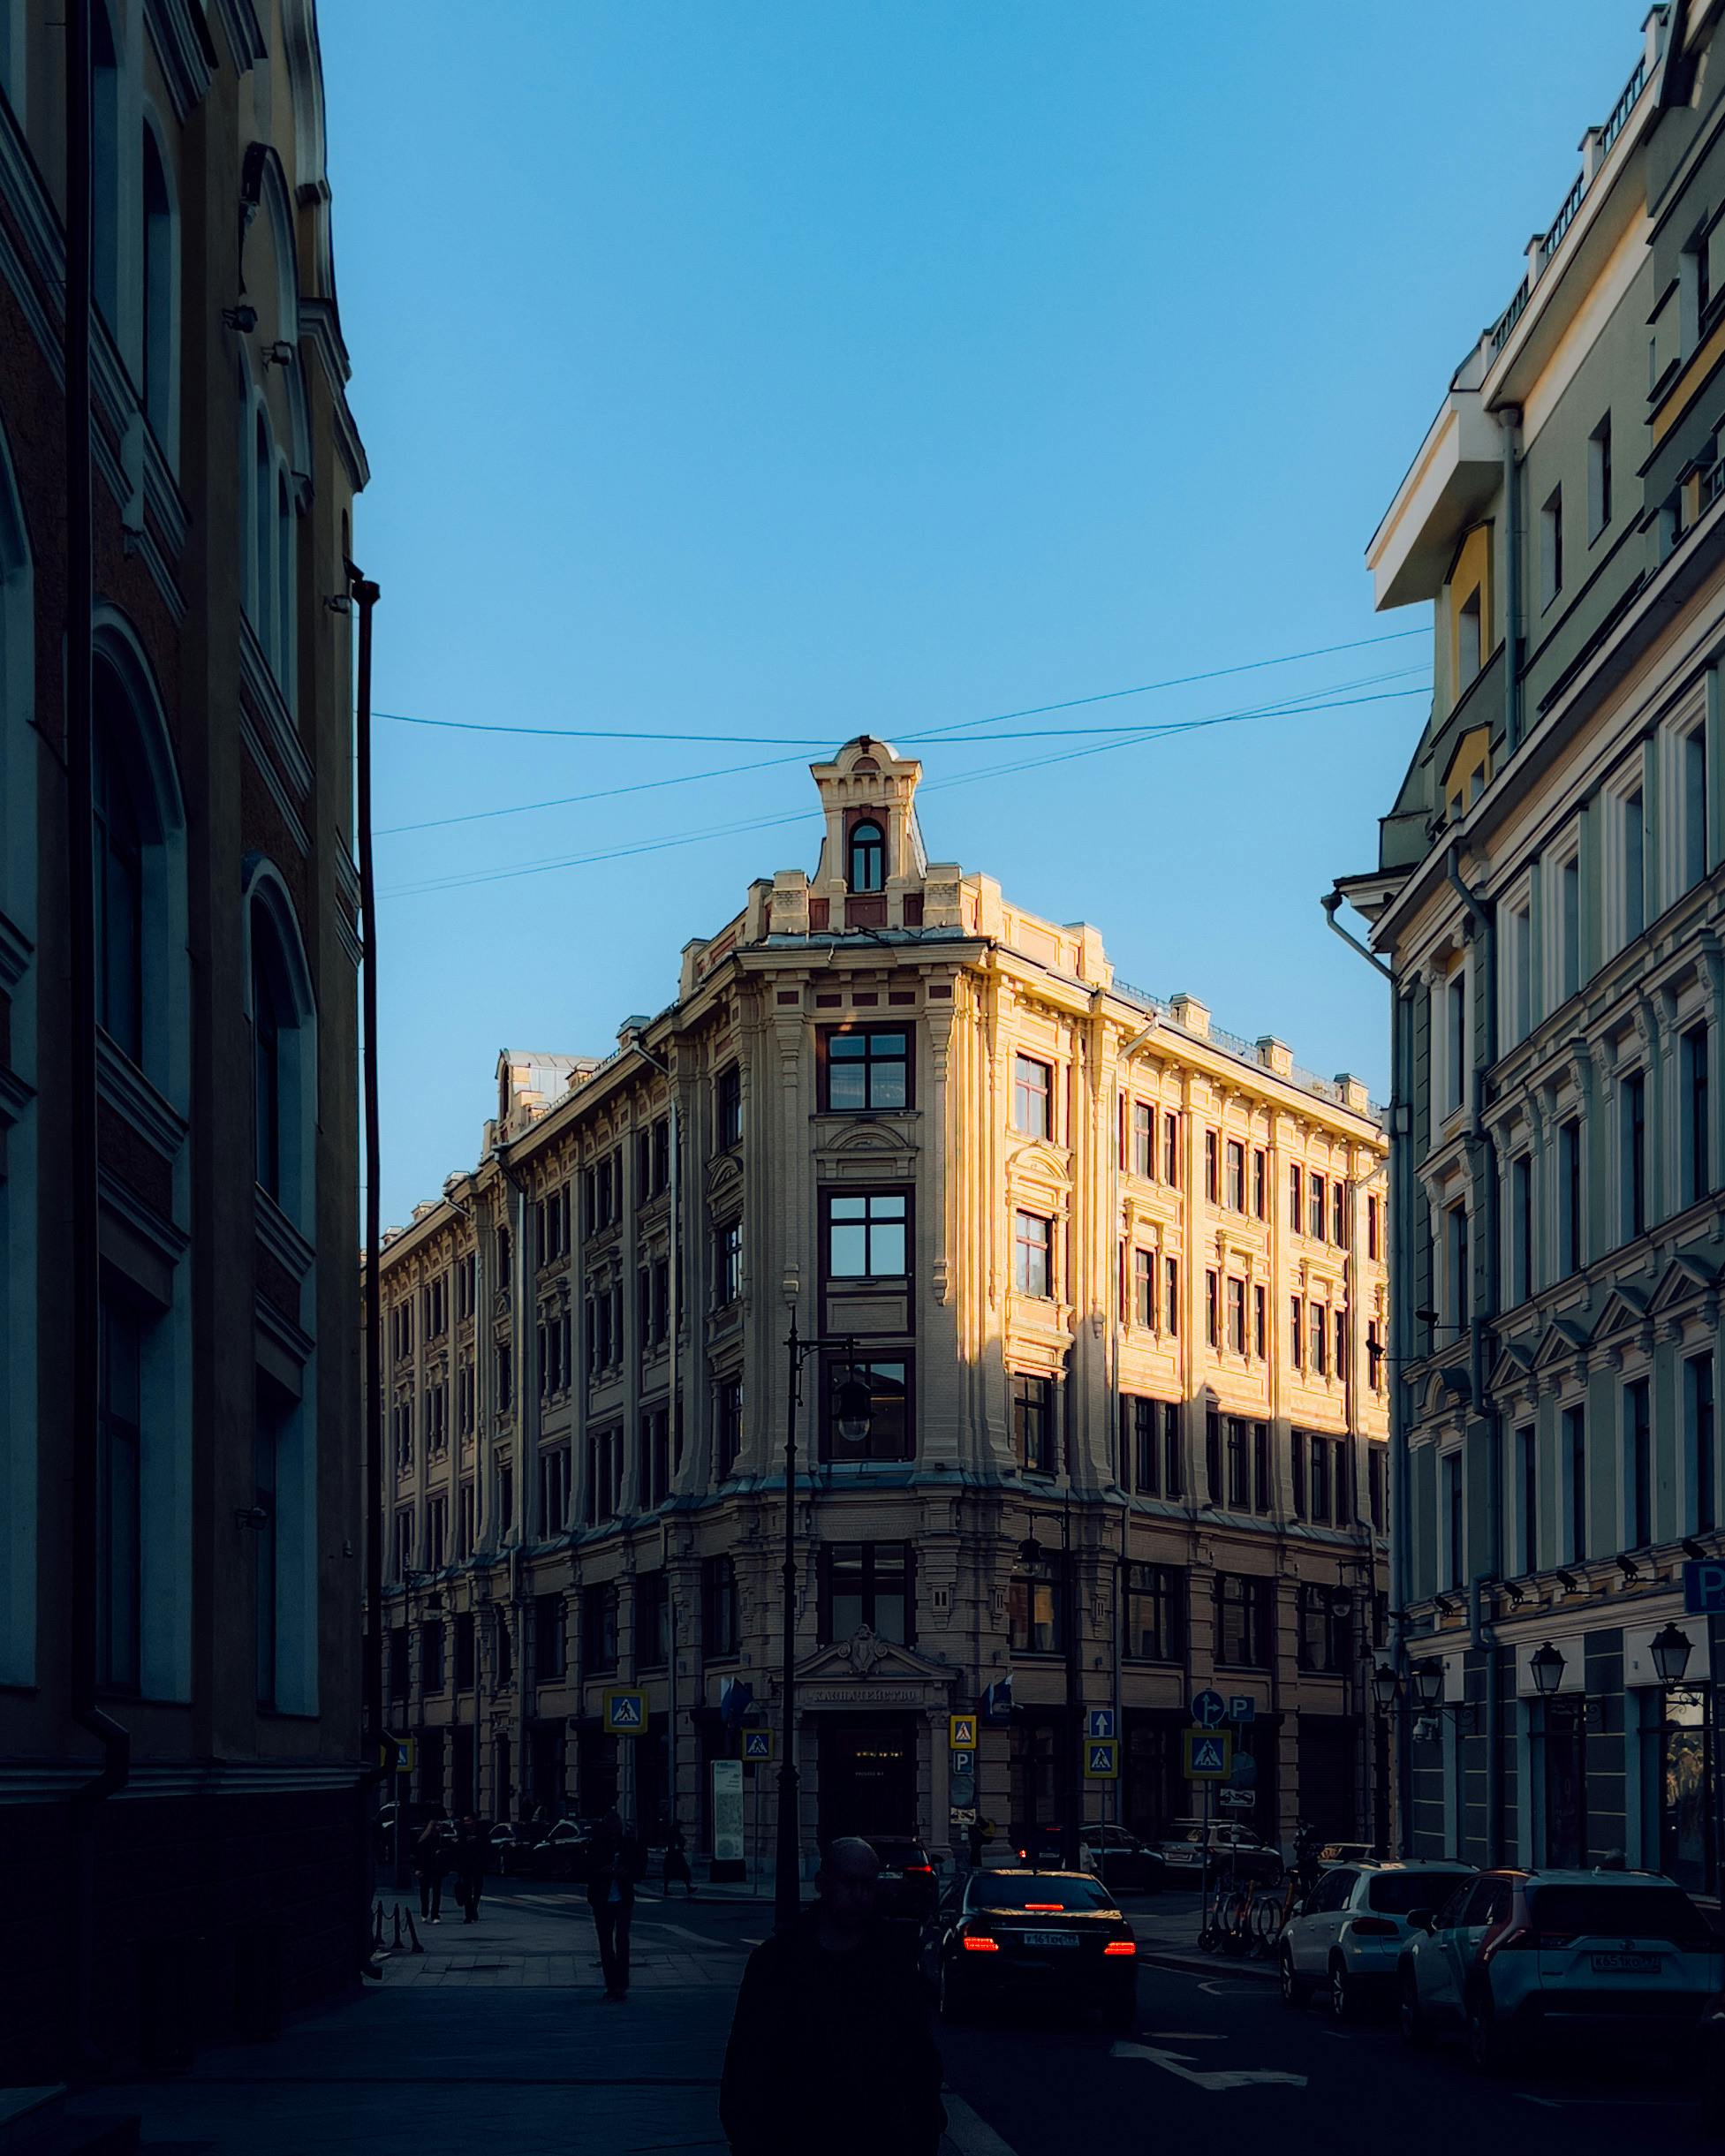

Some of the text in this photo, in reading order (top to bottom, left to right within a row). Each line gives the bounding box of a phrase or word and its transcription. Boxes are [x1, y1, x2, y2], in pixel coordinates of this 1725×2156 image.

[1699, 1566, 1725, 1607] P
[813, 1687, 917, 1703] КАЗНАЧЕЙСТВО
[1233, 1699, 1247, 1717] P
[957, 1753, 968, 1771] P
